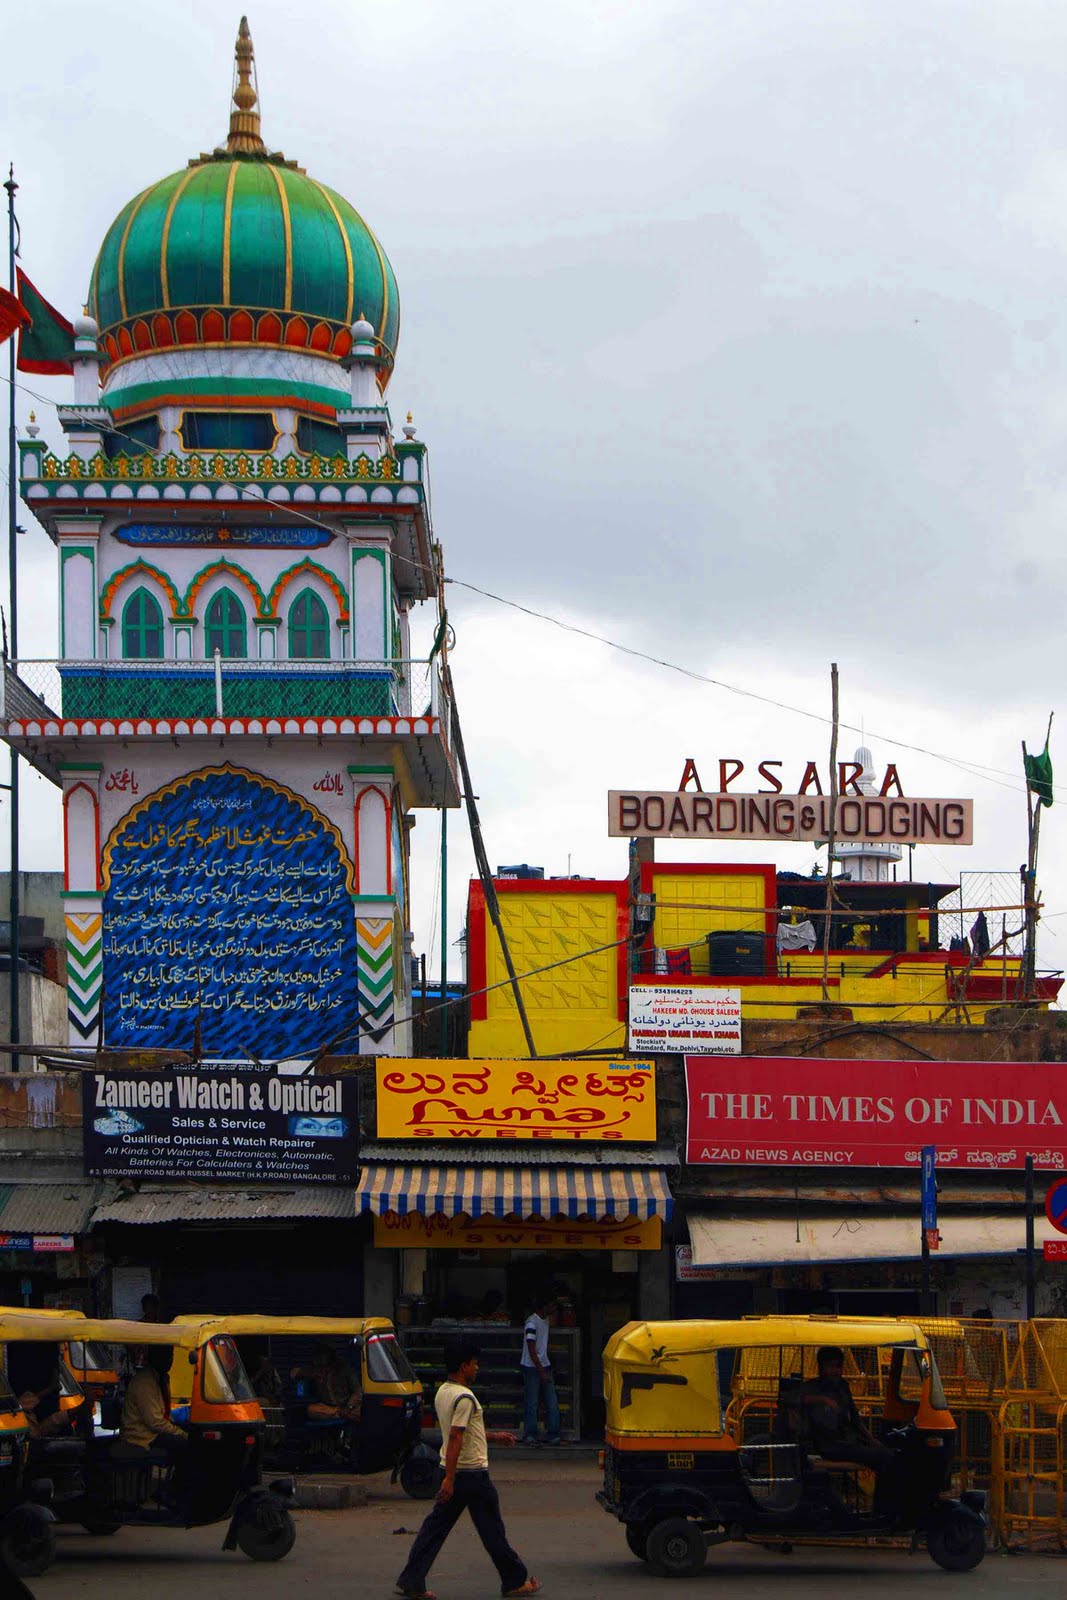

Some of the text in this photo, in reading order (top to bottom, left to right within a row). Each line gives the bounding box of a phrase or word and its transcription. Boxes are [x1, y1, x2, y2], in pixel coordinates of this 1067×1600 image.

[678, 758, 905, 798] APSARA
[619, 795, 964, 839] BOARDING & LODGING
[140, 824, 166, 849] قول
[239, 824, 272, 849] غوث
[271, 828, 318, 851] حضرت
[264, 860, 285, 880] پھول
[319, 860, 341, 880] زبان
[313, 966, 342, 988] خوشیاں
[691, 1008, 714, 1016] GHOUSE
[608, 1063, 630, 1071] Since
[95, 1075, 343, 1114] Zameer Watch & Optical
[701, 1092, 1063, 1126] THE TIMES OF INDIA
[171, 1116, 266, 1130] Sales & Service
[122, 1134, 316, 1149] Qualified Optician & Watch Repairer
[413, 1128, 625, 1139] SWEETS
[104, 1147, 119, 1155] All
[121, 1147, 149, 1156] Kinds
[152, 1148, 165, 1156] Of
[167, 1148, 213, 1158] Watches,
[282, 1151, 336, 1161] Automatic,
[701, 1148, 854, 1164] AZAD NEWS AGENCY
[129, 1157, 310, 1171] Batteries For Calculaters & Watches
[103, 1168, 142, 1176] BROADWAY
[144, 1169, 164, 1177] ROAD
[187, 1170, 215, 1178] RUSSEL
[217, 1171, 245, 1179] MARKET
[293, 1173, 337, 1181] BANGALORE
[466, 1233, 642, 1246] SWEETS
